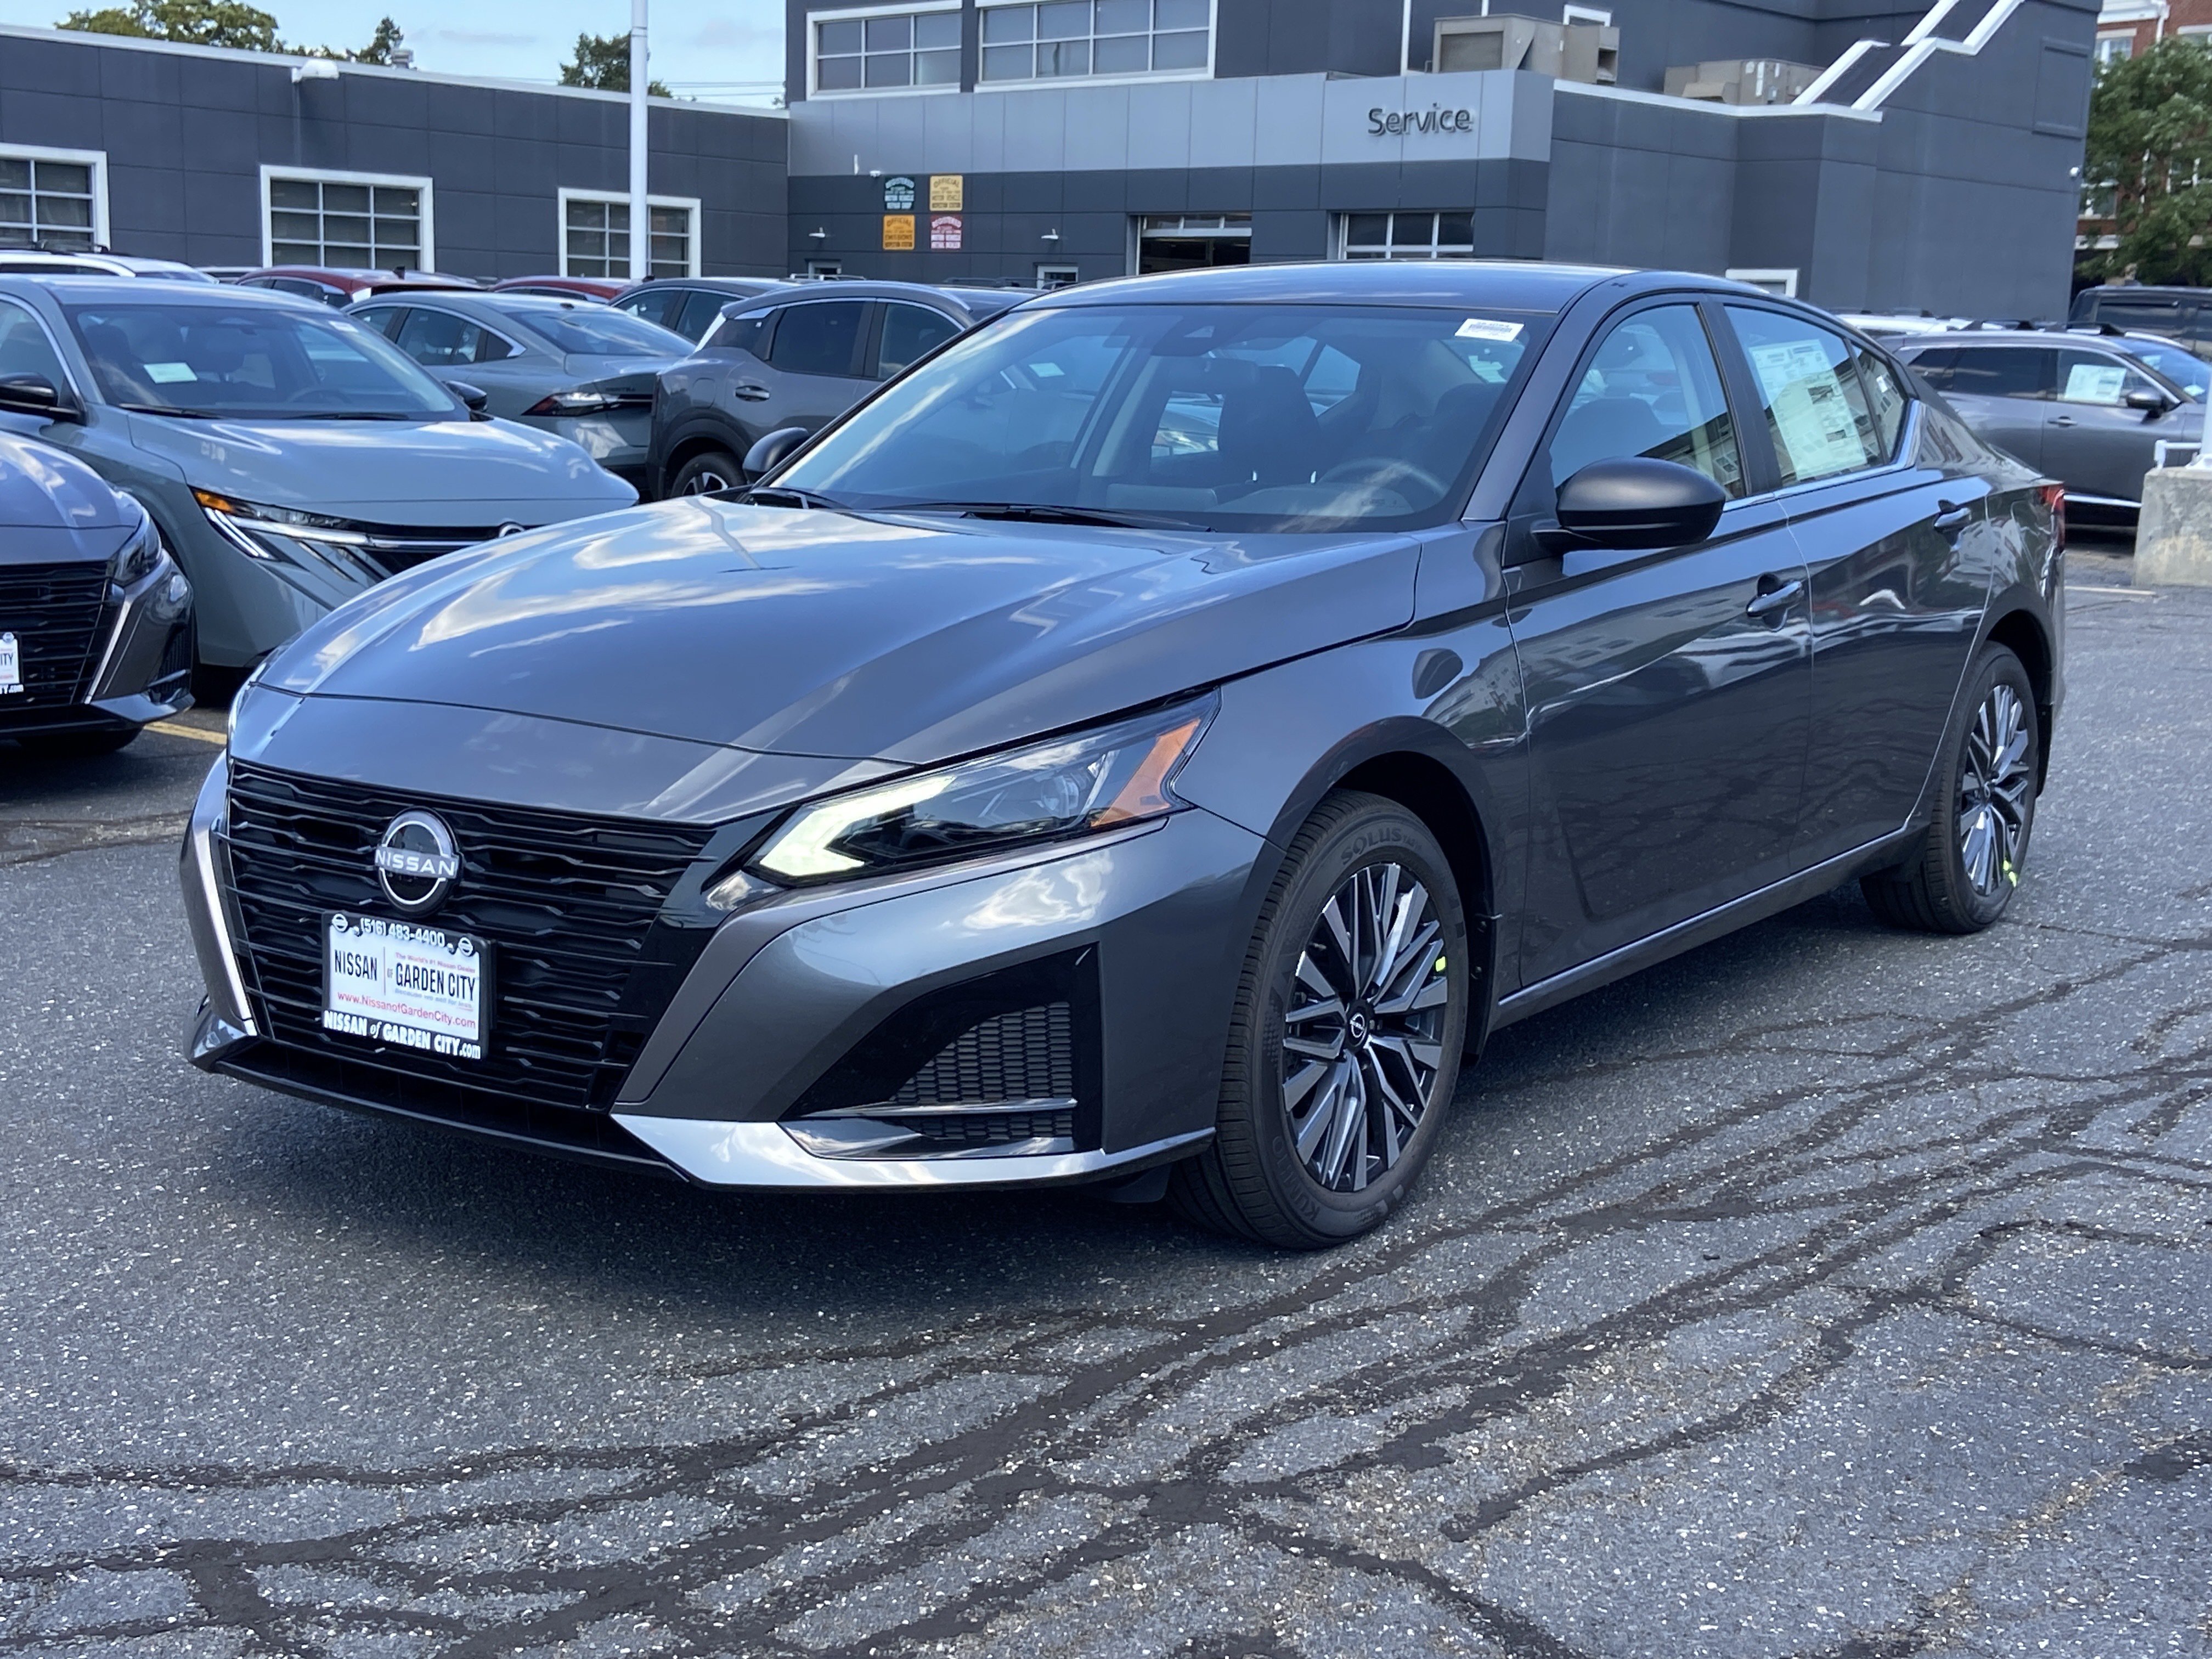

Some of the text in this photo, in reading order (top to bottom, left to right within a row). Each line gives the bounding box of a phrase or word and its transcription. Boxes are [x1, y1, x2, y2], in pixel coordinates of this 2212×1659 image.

[1368, 103, 1472, 135] Service
[1, 653, 13, 665] ITY
[375, 849, 455, 876] NISSAN
[1341, 828, 1403, 865] SOLUS
[360, 917, 445, 948] (516) 483-4400
[335, 950, 377, 981] NISSAN
[396, 962, 444, 995] GARDEN
[448, 973, 476, 1001] CITY
[337, 991, 476, 1029] www.NissanofGardenCity.com
[324, 1010, 367, 1036] NISSAN
[370, 1022, 382, 1039] of
[383, 1023, 431, 1049] GARDEN
